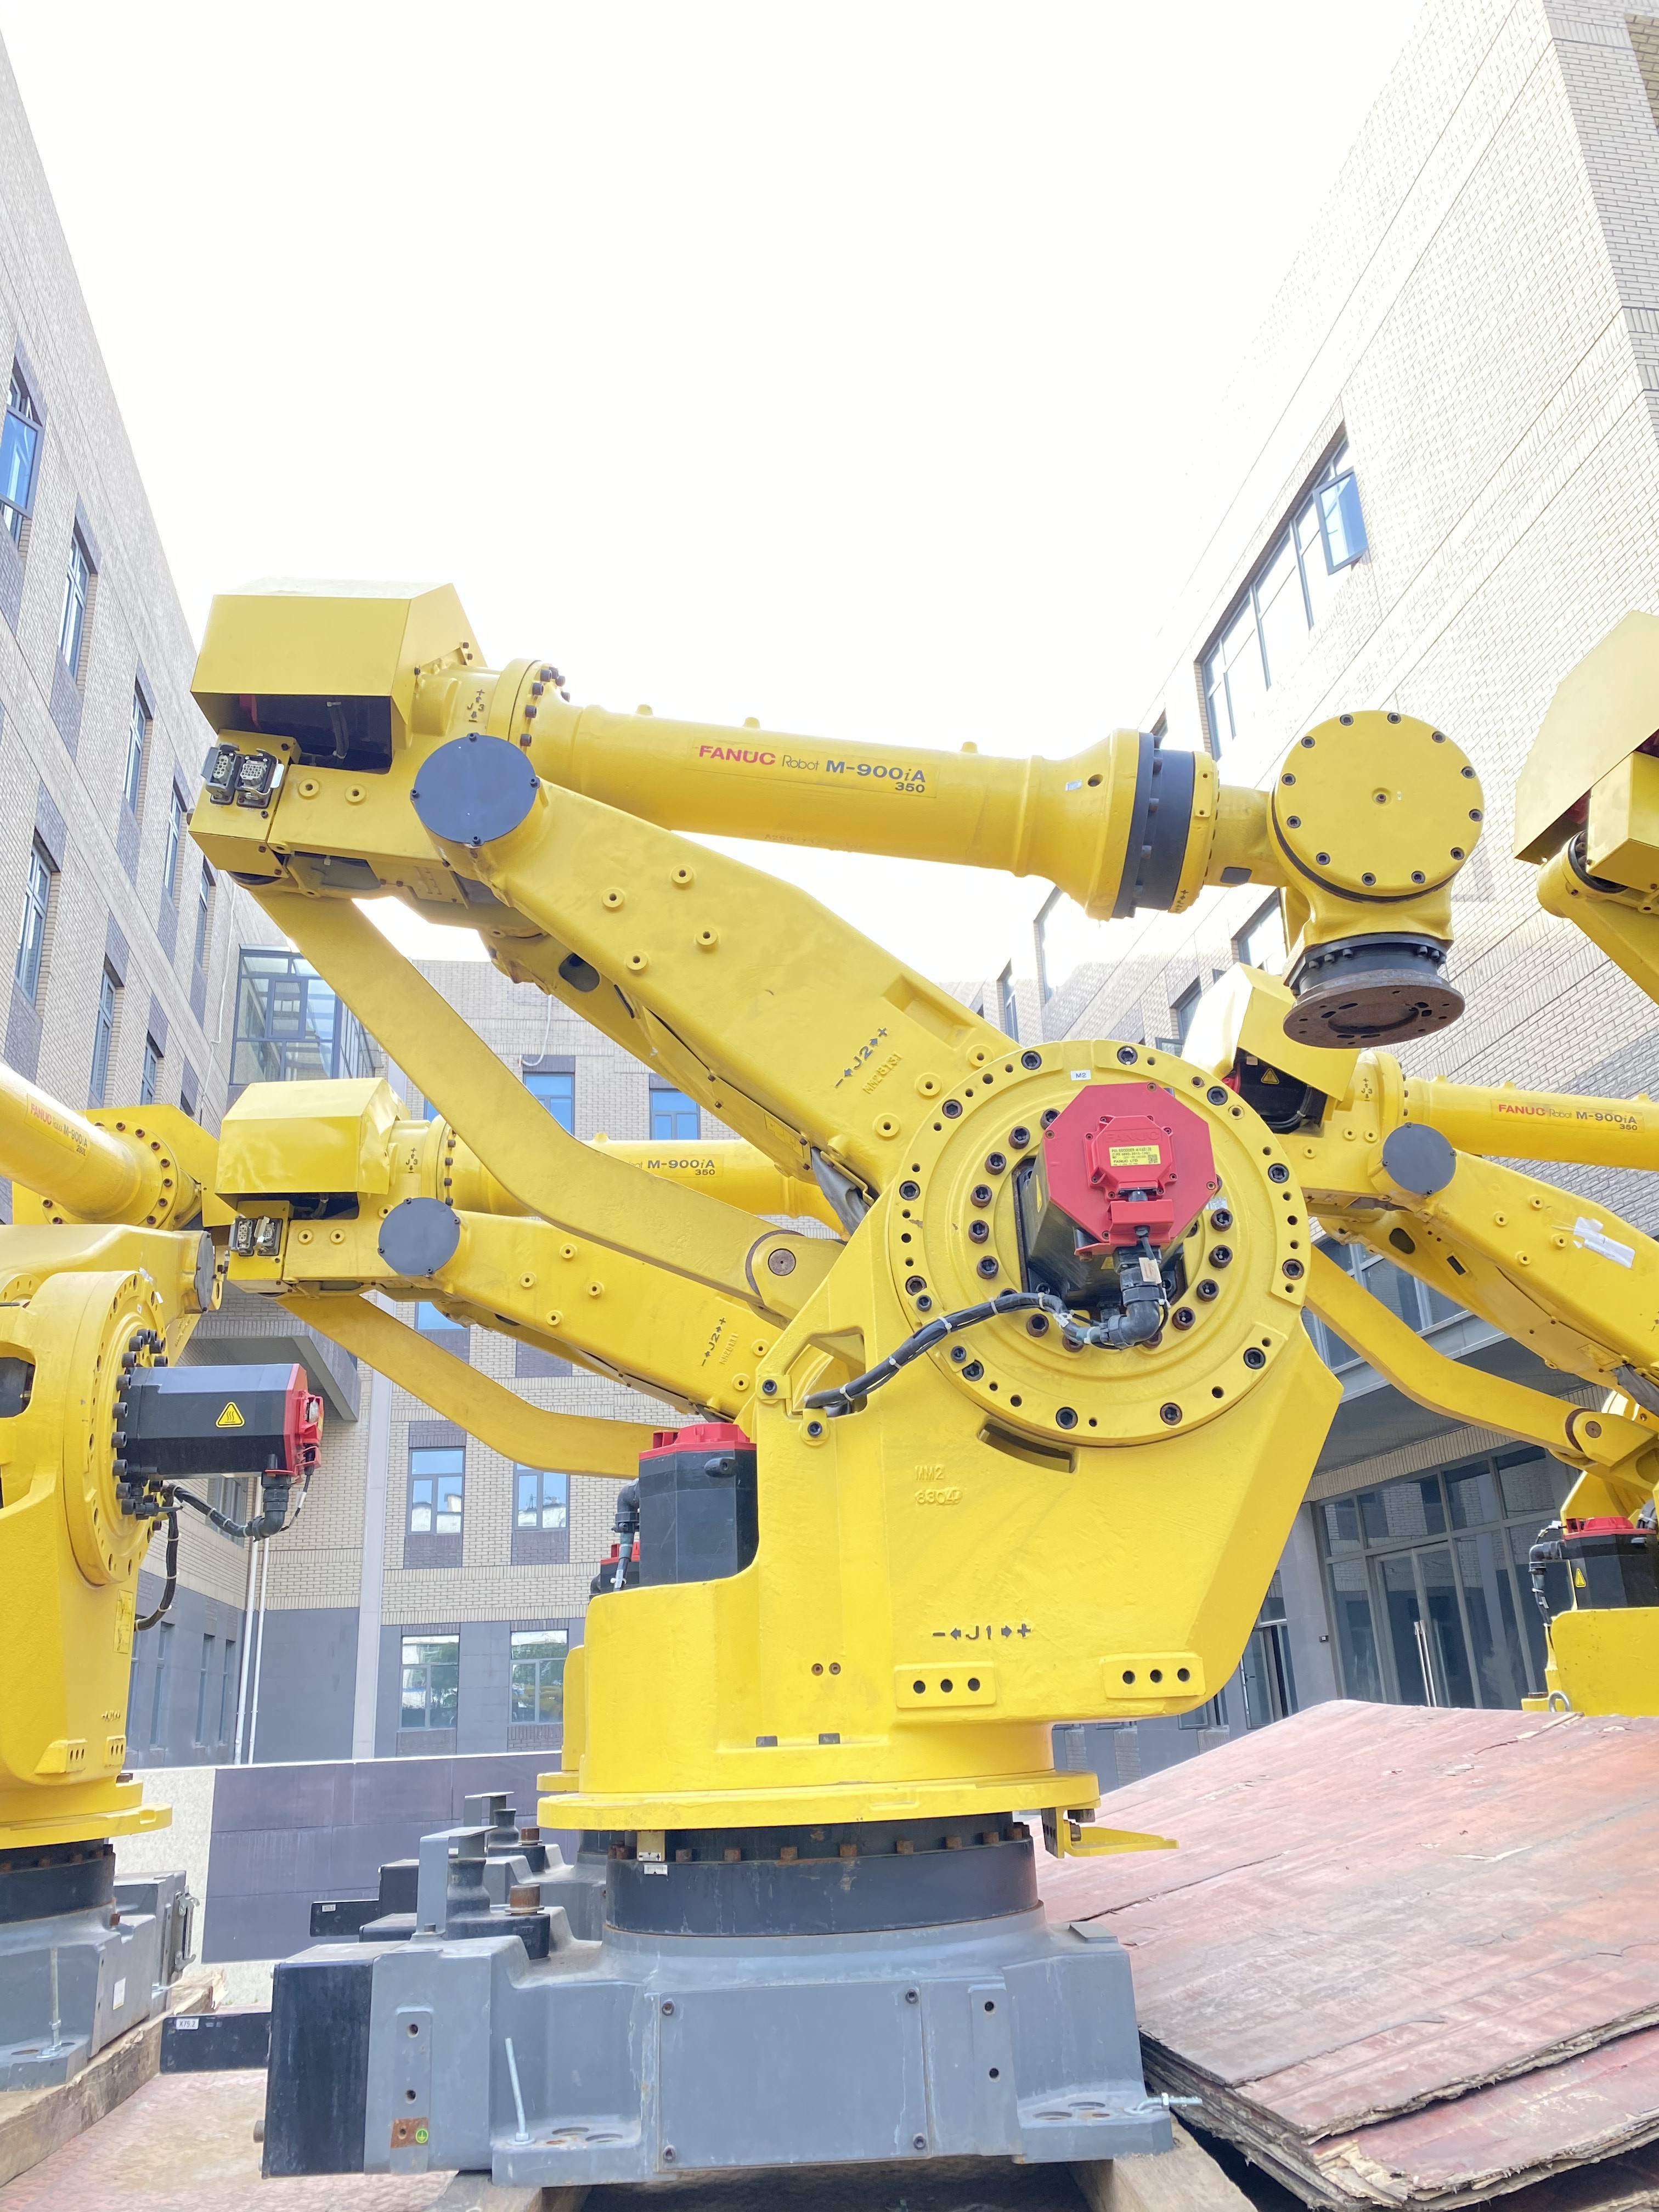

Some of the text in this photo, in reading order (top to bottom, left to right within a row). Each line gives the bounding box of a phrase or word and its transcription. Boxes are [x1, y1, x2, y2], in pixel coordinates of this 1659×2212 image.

[699, 745, 926, 783] FANUC Robot M-900iA
[895, 782, 926, 793] 350
[1498, 1104, 1637, 1124] FANUC Robot M-900iA
[31, 1102, 52, 1125] FANUC
[63, 1124, 88, 1148] M-900iA
[1106, 1131, 1160, 1143] FANUC
[647, 1159, 715, 1169] M-900iA
